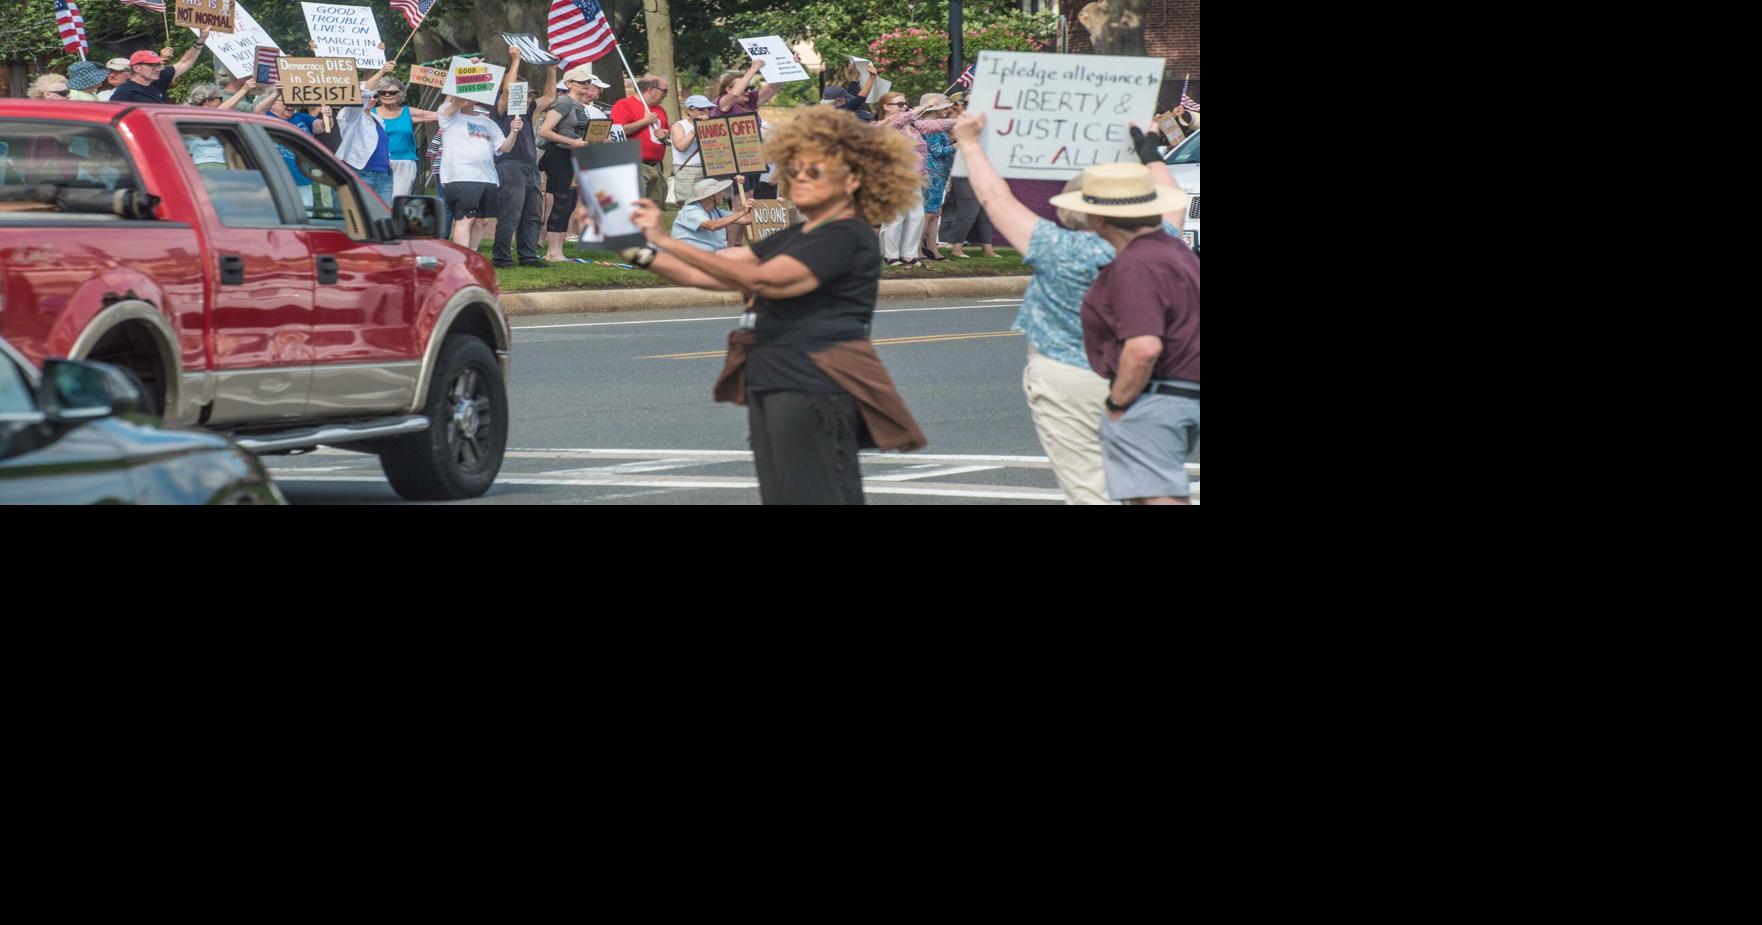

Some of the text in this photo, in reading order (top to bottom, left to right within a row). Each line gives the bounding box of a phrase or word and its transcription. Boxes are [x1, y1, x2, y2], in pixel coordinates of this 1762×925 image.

[316, 6, 356, 15] GOOD
[177, 7, 193, 22] NOT
[195, 12, 232, 28] NORMAL
[311, 15, 368, 25] TROUBLE
[313, 24, 369, 34] LIVES ON
[217, 36, 260, 53] WE WILL
[317, 36, 376, 47] MARCH IN
[232, 49, 255, 62] NOT
[328, 46, 369, 56] PEACE
[281, 59, 353, 73] Democracy DIES
[355, 58, 384, 66] OWER
[290, 71, 351, 84] in Silence
[458, 67, 477, 75] GOOD
[1000, 62, 1057, 87] pledge
[1062, 65, 1142, 87] allegiance
[412, 73, 444, 86] TROUBL
[292, 85, 355, 104] RESIST!
[994, 89, 1132, 115] LIBERTY &
[698, 119, 757, 139] HANDS OFF!
[997, 118, 1124, 142] JUSTICE
[1008, 144, 1046, 164] for
[754, 207, 787, 224] NO ONE
